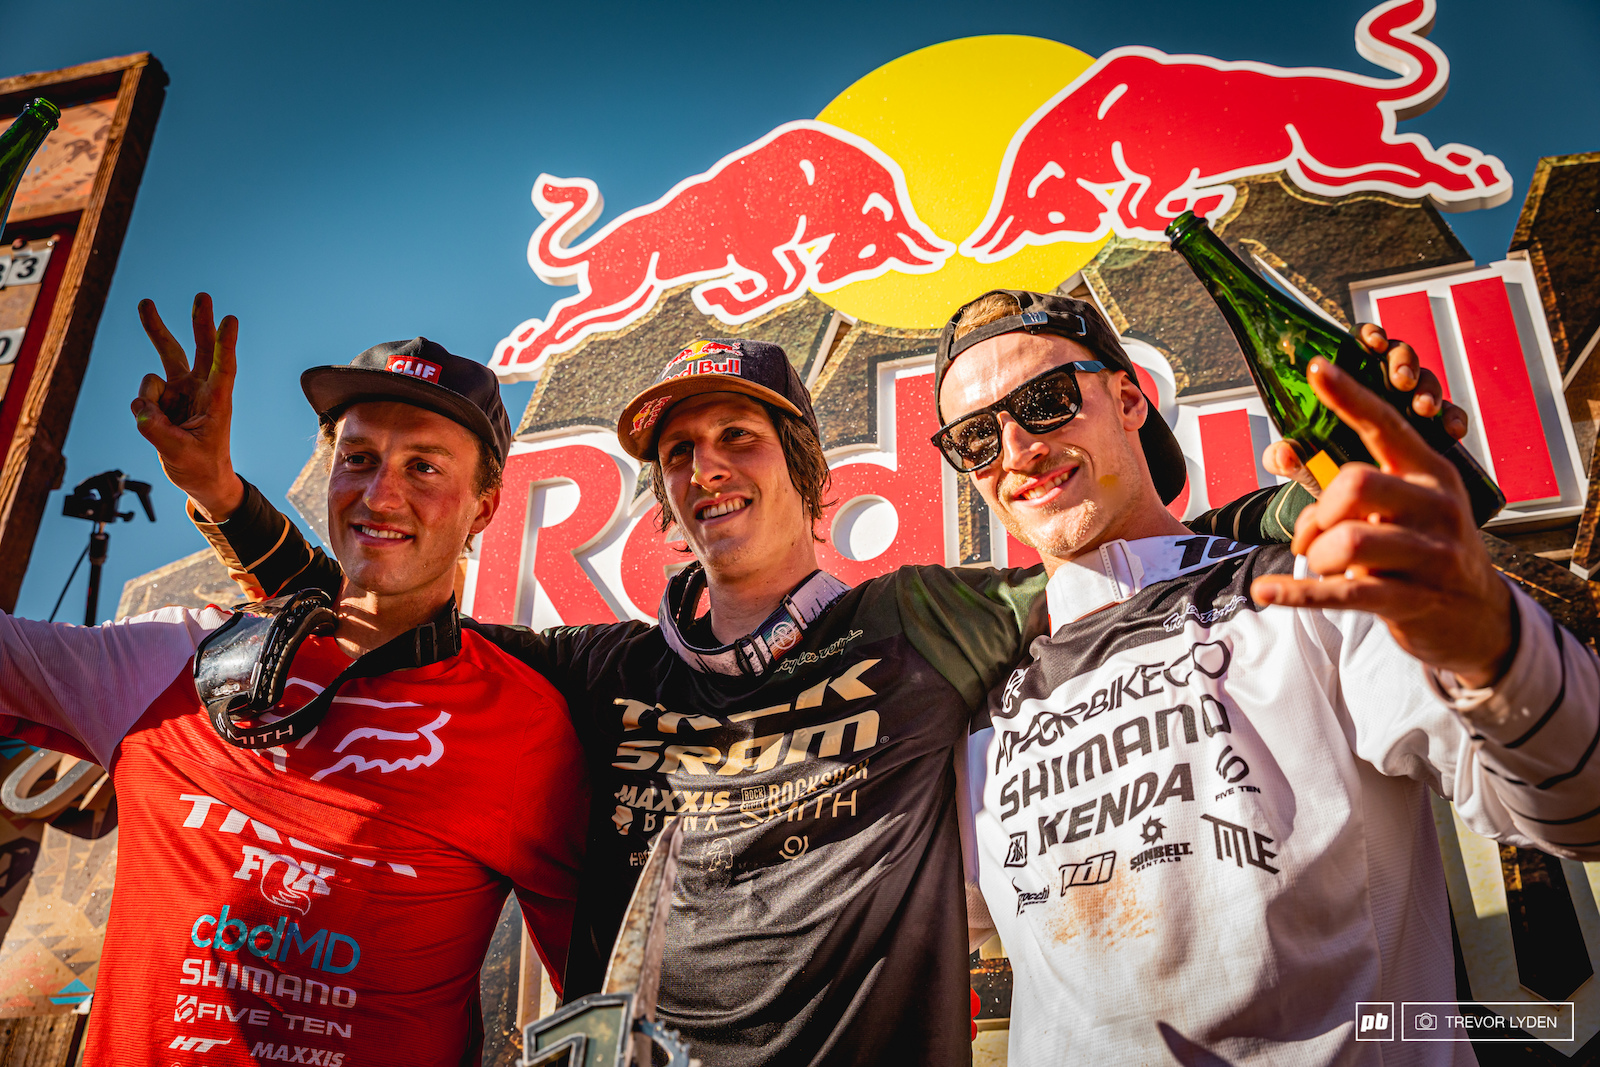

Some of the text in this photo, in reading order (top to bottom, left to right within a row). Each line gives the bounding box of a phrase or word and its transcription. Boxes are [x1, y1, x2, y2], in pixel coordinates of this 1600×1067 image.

[391, 359, 436, 379] CLIF
[697, 358, 741, 375] Bull
[1006, 275, 1562, 569] ll
[611, 709, 881, 776] SRAM
[999, 693, 1232, 823] SHIMANO
[613, 784, 731, 813] MAXXIS
[740, 789, 858, 829] SITH
[1037, 762, 1196, 856] KENDA
[1215, 785, 1261, 802] FIVE TEN
[179, 793, 418, 878] TR
[1136, 856, 1182, 873] RENTALS
[190, 904, 361, 975] cbdMD
[179, 958, 358, 1009] SHIMANO
[197, 1002, 352, 1039] FIVE TEN
[168, 1035, 232, 1053] HT
[250, 1041, 346, 1067] MAXXIS
